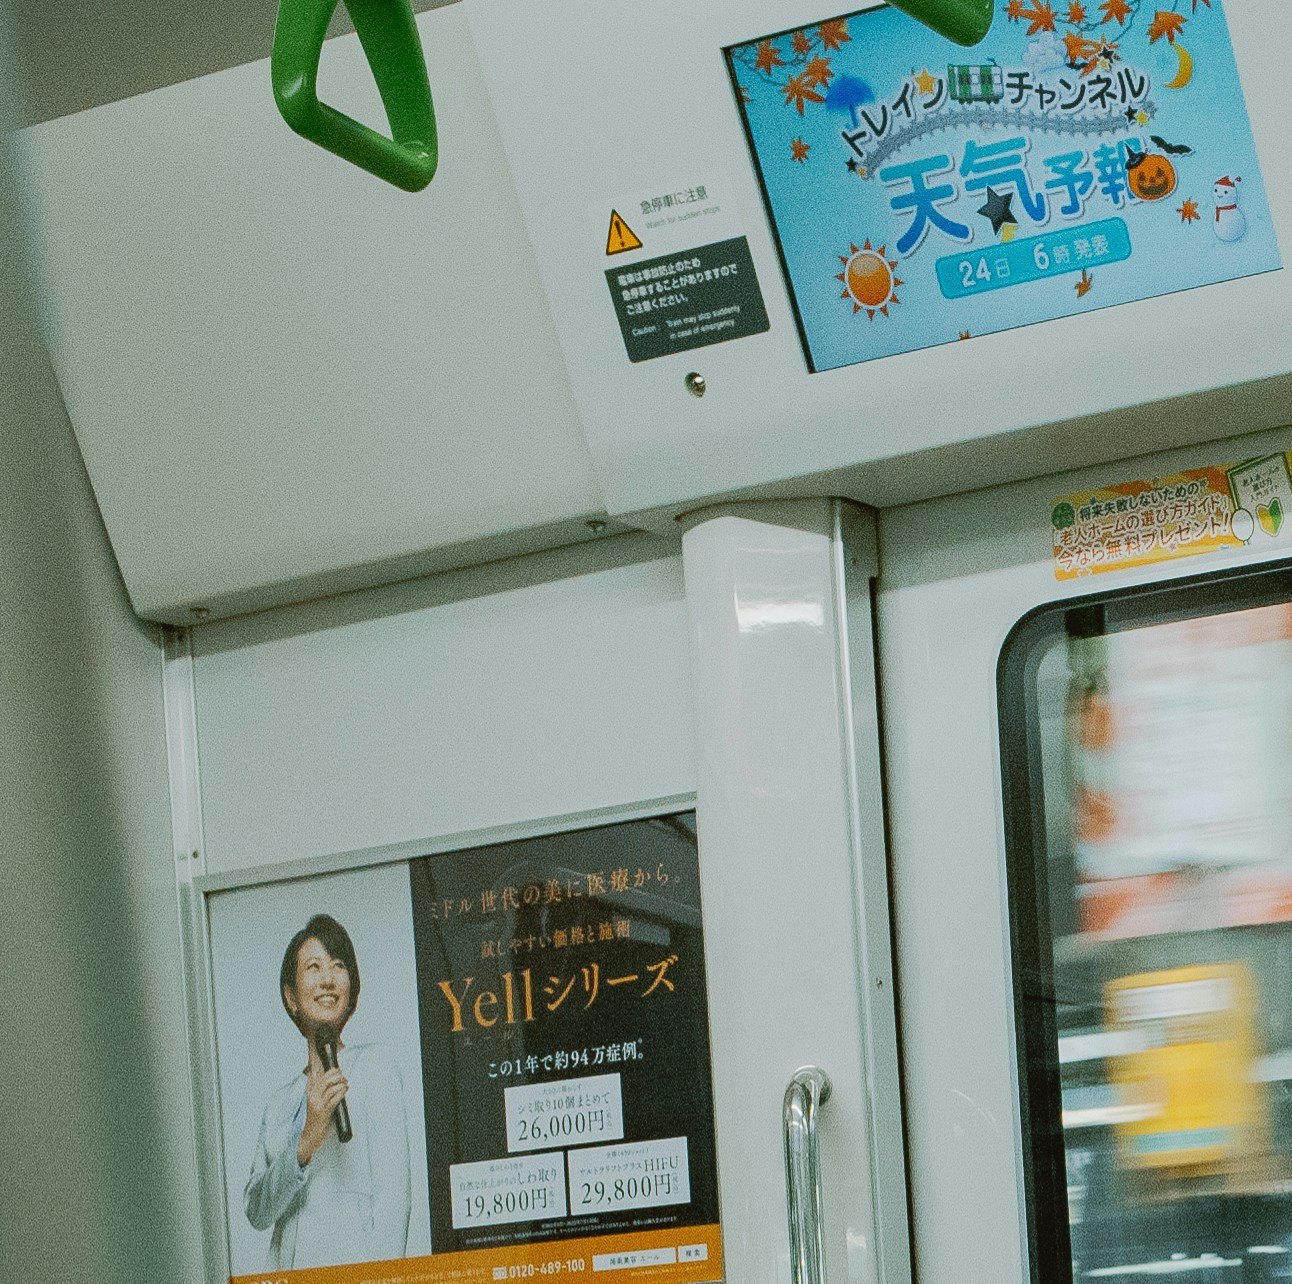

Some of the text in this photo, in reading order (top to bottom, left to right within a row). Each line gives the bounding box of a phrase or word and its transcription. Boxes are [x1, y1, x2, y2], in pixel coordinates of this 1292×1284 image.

[841, 66, 1147, 157] トレイン チャンネル
[640, 185, 708, 215] 急停車に注意
[879, 135, 1144, 254] 天気予報
[517, 1109, 605, 1142] 26,000円
[464, 1187, 549, 1219] 19,800円
[581, 1173, 672, 1205] 29,800円
[508, 1258, 586, 1279] 0120-489-100
